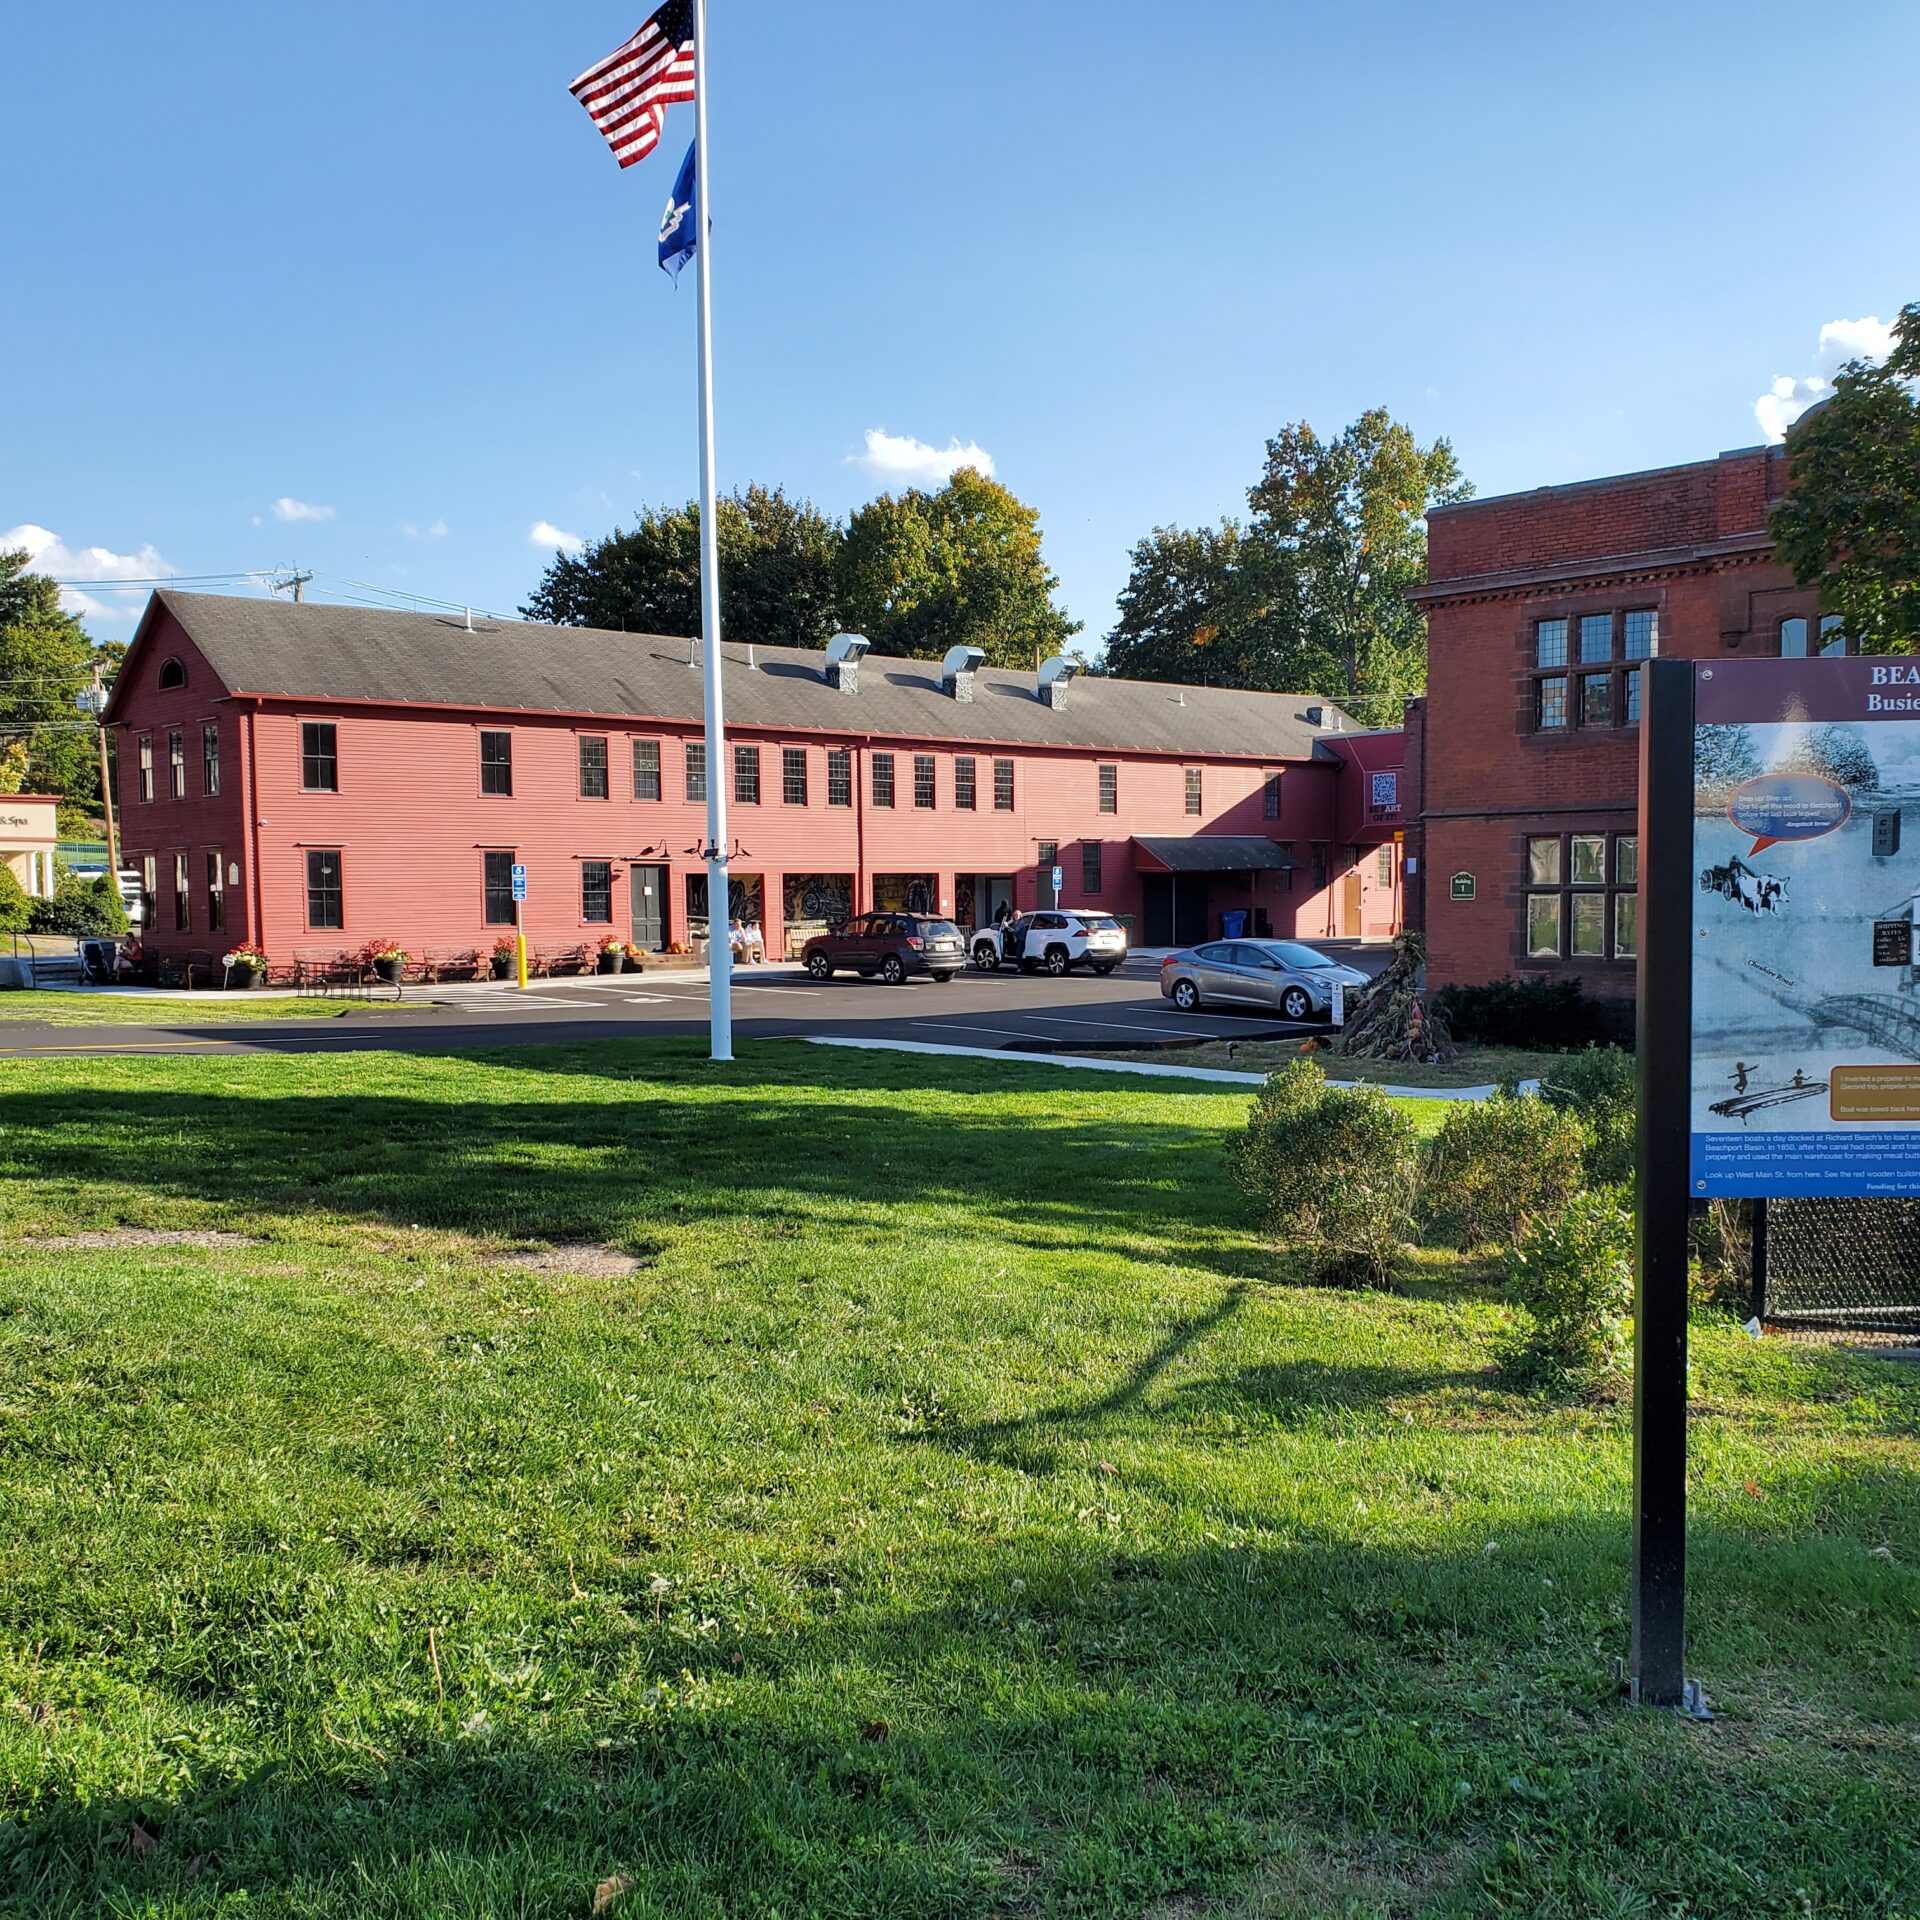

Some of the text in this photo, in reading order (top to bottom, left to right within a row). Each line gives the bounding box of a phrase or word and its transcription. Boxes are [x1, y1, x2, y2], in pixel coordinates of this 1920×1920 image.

[1871, 665, 1920, 685] BEA
[1867, 692, 1920, 711] Busie
[8, 816, 28, 827] Spa
[1747, 960, 1795, 986] Cheshire Road
